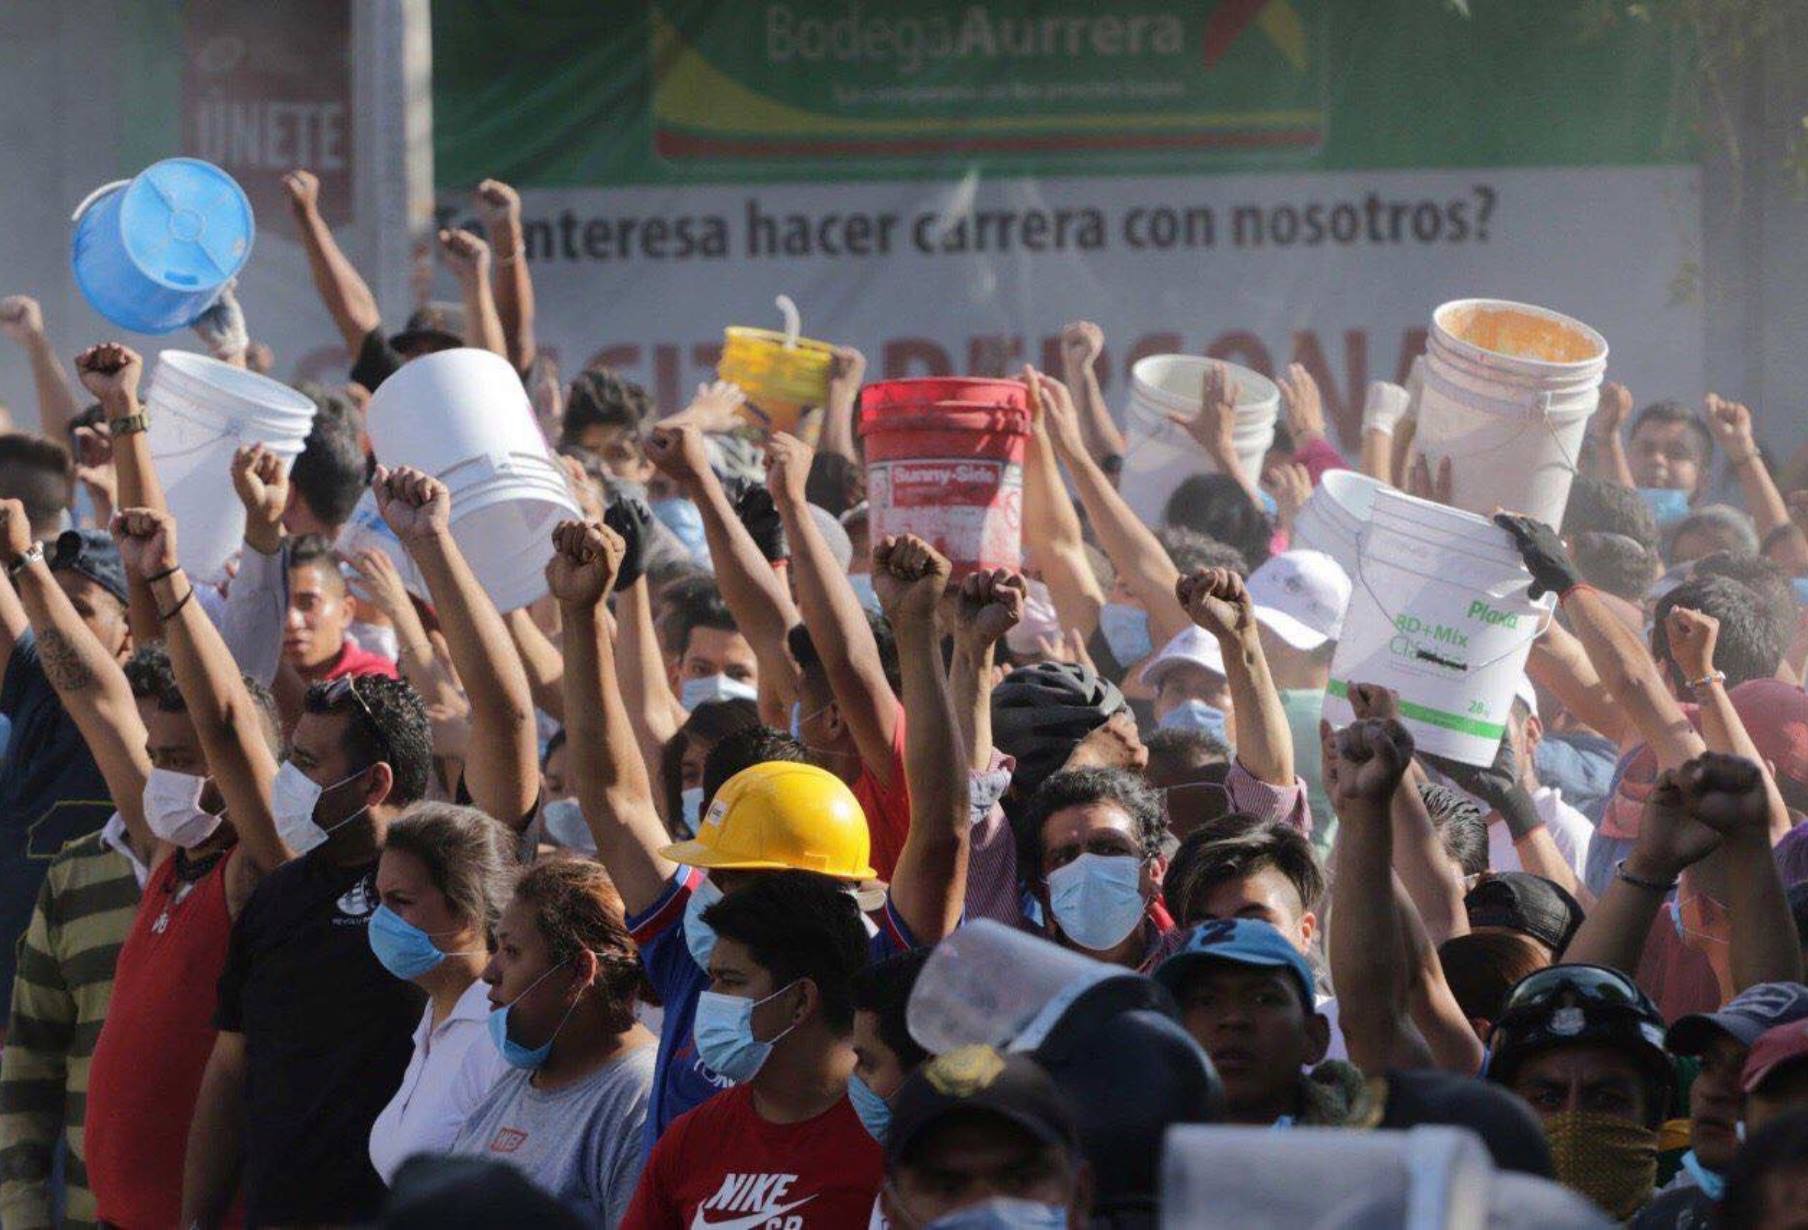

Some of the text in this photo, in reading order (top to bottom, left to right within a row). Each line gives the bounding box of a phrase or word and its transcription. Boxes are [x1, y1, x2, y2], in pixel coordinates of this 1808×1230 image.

[520, 208, 731, 261] nteresa
[745, 198, 899, 257] hacer
[911, 205, 1105, 254] carrera
[1123, 204, 1216, 248] con
[1231, 184, 1496, 247] nosotros?
[704, 1173, 800, 1213] NIKE
